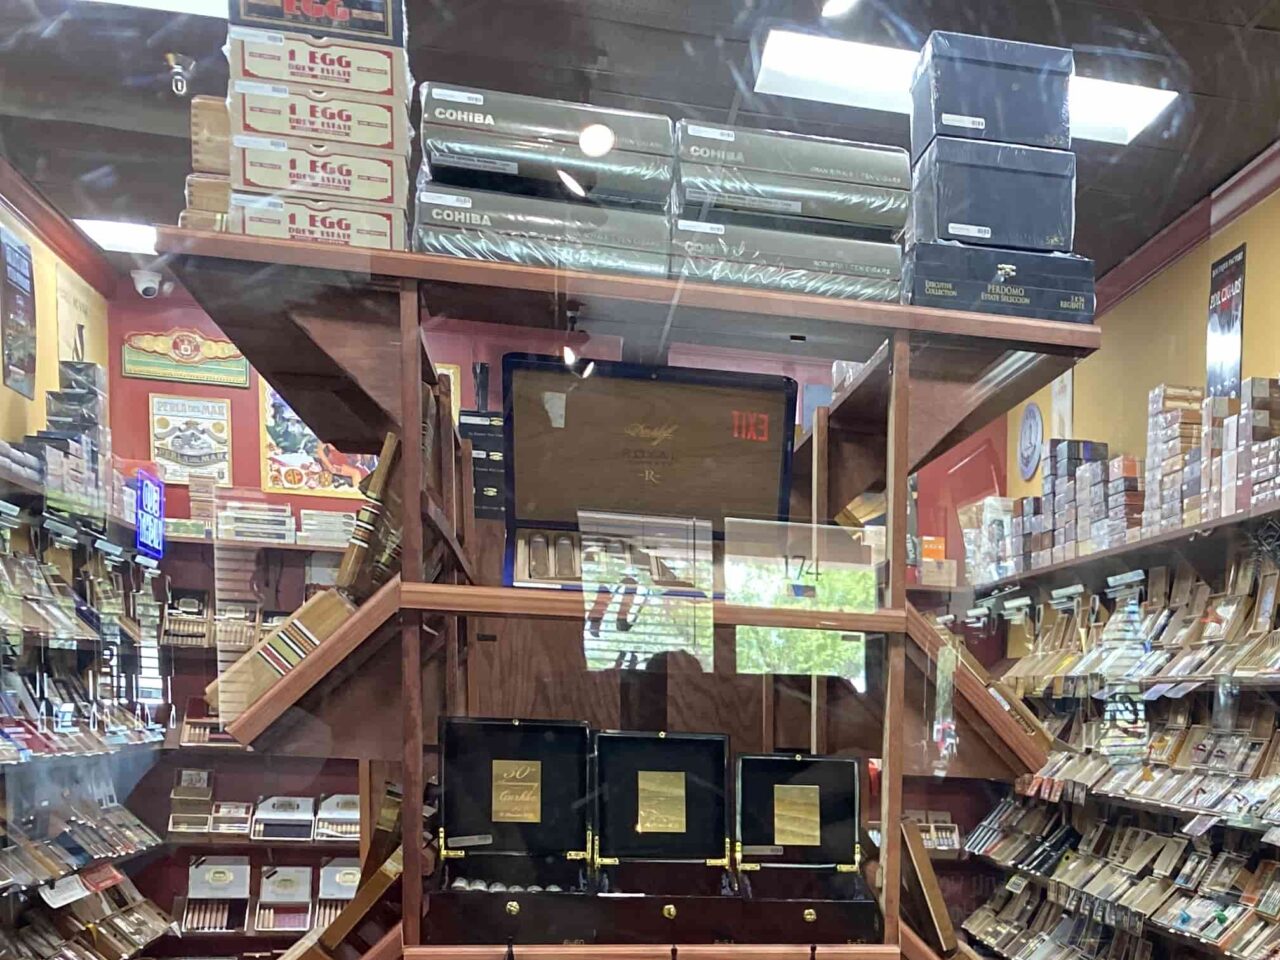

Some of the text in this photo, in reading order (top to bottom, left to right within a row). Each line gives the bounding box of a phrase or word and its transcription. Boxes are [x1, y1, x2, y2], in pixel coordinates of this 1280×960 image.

[288, 49, 296, 61] 1
[308, 51, 351, 69] EGG
[288, 103, 352, 122] 1 EGG
[434, 107, 495, 126] COHIBA
[690, 145, 745, 163] COHIBA
[289, 158, 352, 177] 1 EGG
[288, 213, 351, 231] 1 EGG
[432, 208, 492, 226] COHIBA
[987, 284, 1024, 296] PERDOMO
[783, 554, 822, 582] 174
